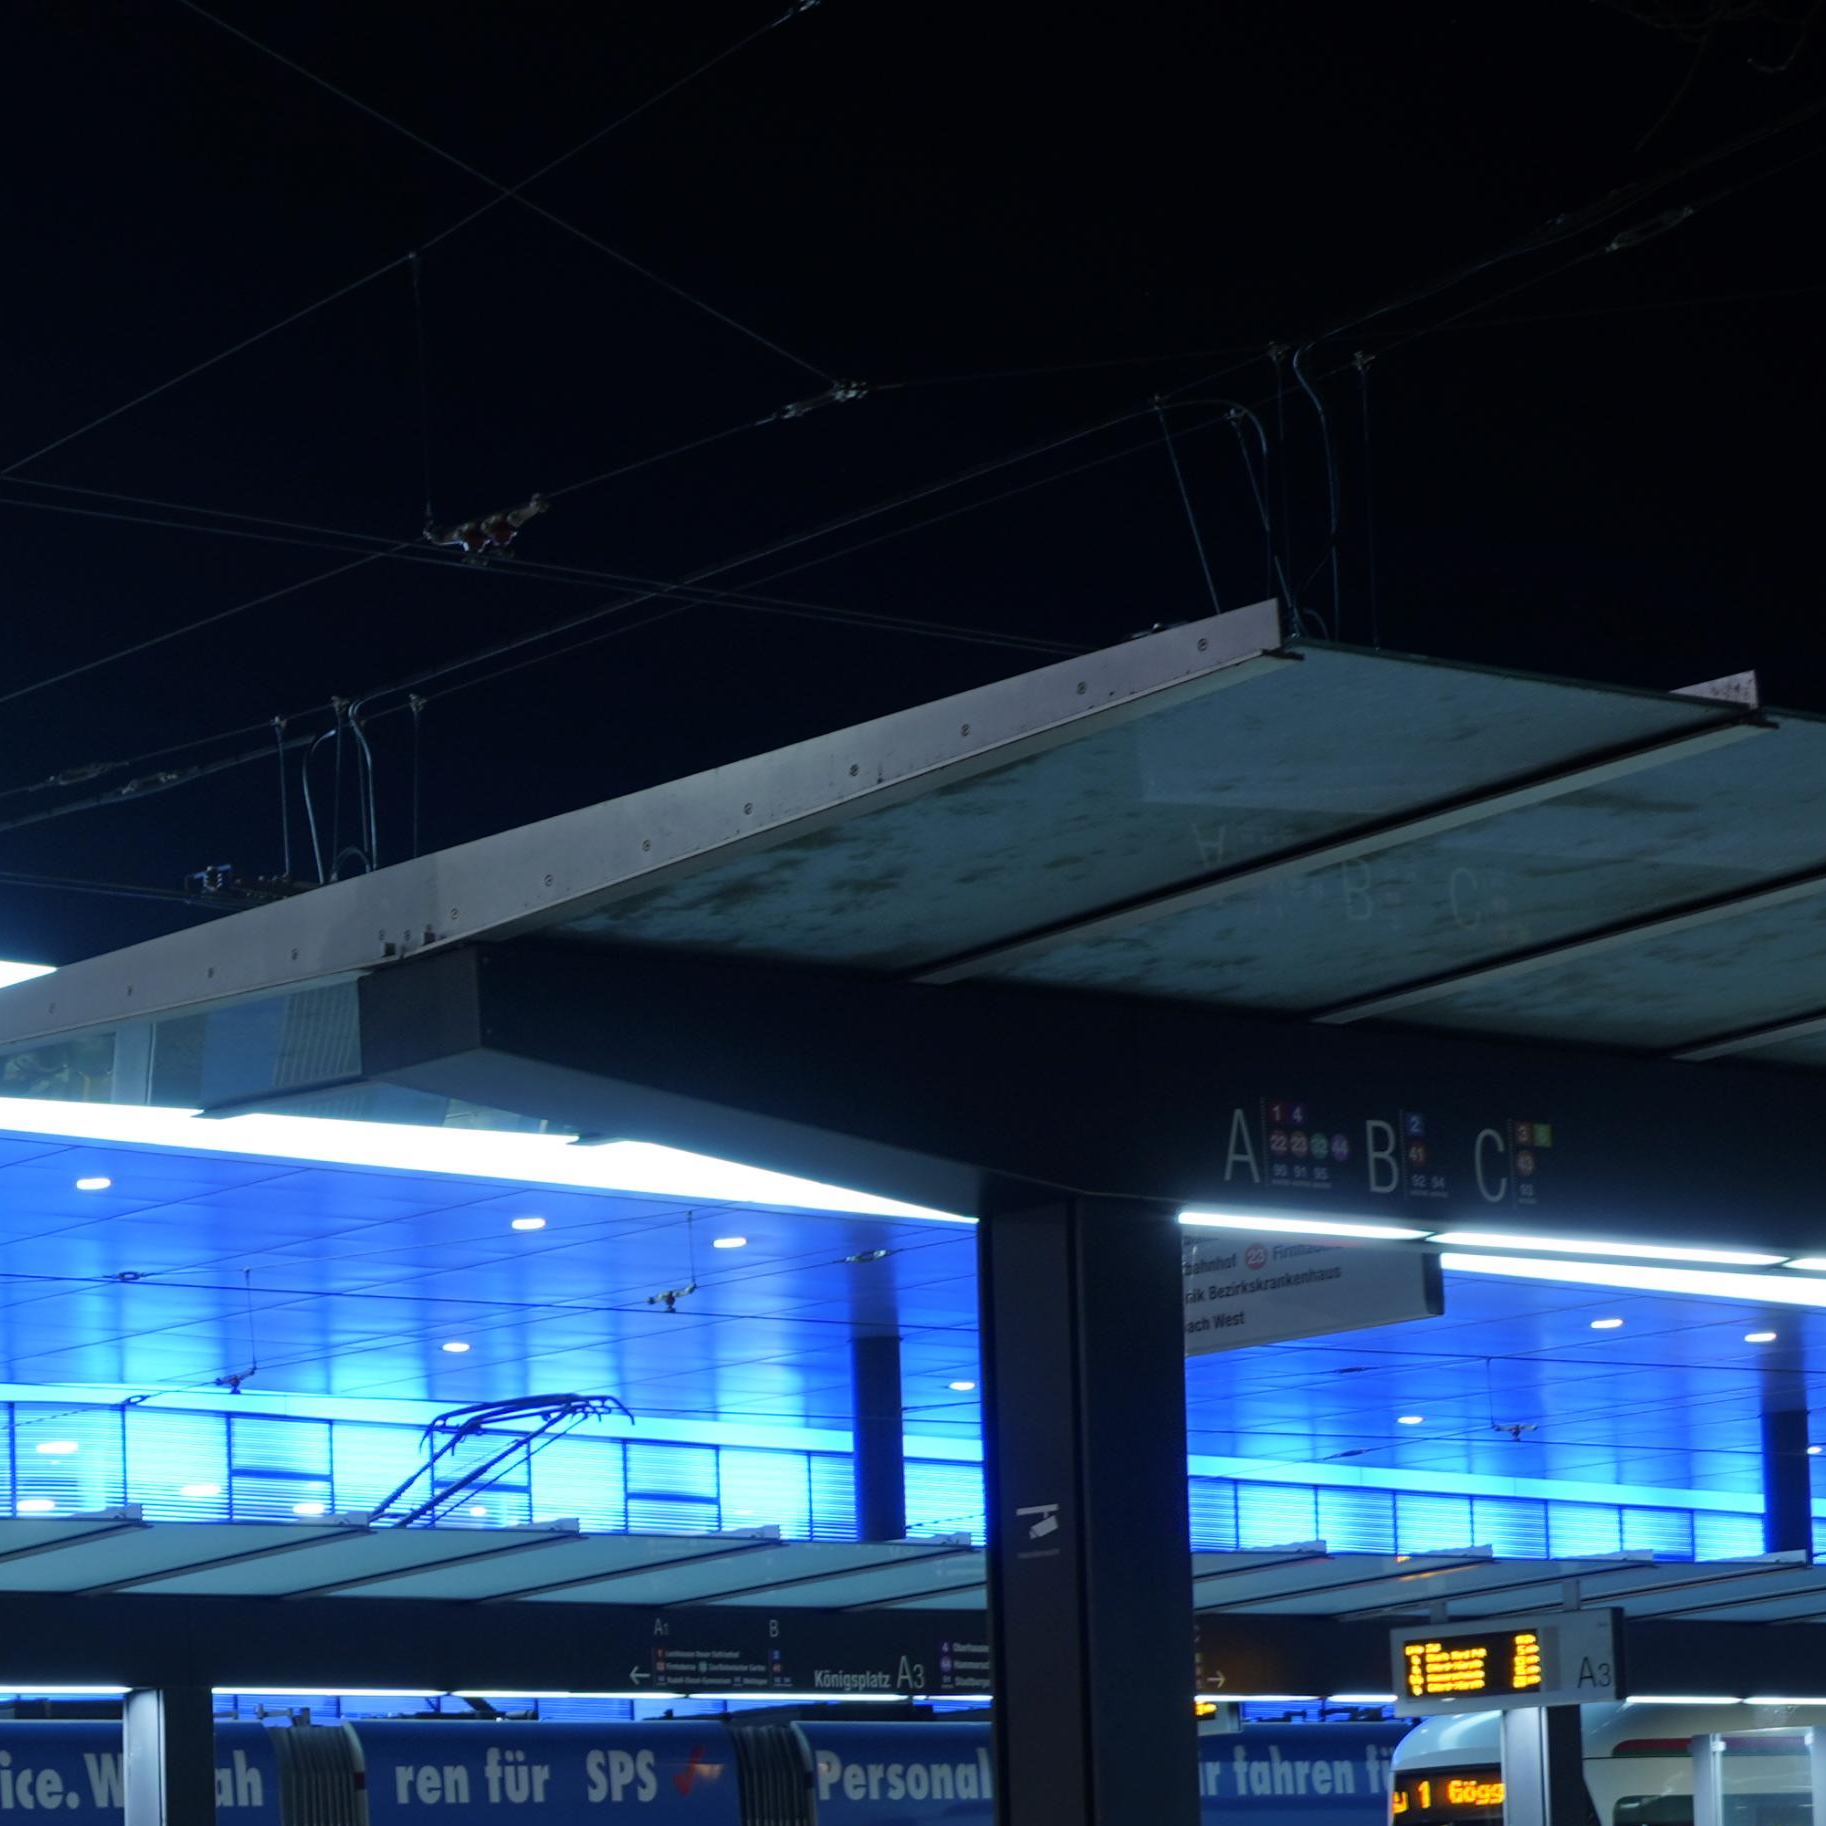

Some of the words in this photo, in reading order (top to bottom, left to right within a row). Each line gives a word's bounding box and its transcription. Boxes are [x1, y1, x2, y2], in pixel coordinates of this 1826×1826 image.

[1272, 1105, 1281, 1121] 1
[1292, 1106, 1304, 1123] 4
[1410, 1115, 1422, 1133] 2
[1224, 1108, 1260, 1183] A
[1270, 1135, 1288, 1151] 22
[1290, 1136, 1308, 1152] 23
[1519, 1125, 1529, 1142] 3
[1365, 1119, 1399, 1193] B
[1409, 1147, 1424, 1162] 41
[1474, 1128, 1508, 1203] C
[1182, 1253, 1237, 1276] bahnhof
[1247, 1249, 1265, 1265] 23
[1185, 1288, 1205, 1304] nik
[1208, 1266, 1342, 1300] Bezirkskrankenhaus
[1186, 1316, 1210, 1333] ach
[1212, 1310, 1245, 1328] West
[769, 1619, 779, 1637] B
[814, 1669, 891, 1692] Königsplatz
[896, 1654, 925, 1689] A3
[1577, 1657, 1611, 1689] A3
[215, 1749, 264, 1807] ah
[395, 1764, 470, 1805] ren
[485, 1747, 549, 1803] für
[586, 1749, 657, 1803] SPS
[816, 1746, 993, 1803] Personal
[1233, 1745, 1356, 1797] fahren
[1417, 1780, 1432, 1809] 1
[1447, 1779, 1506, 1806] Gögg
